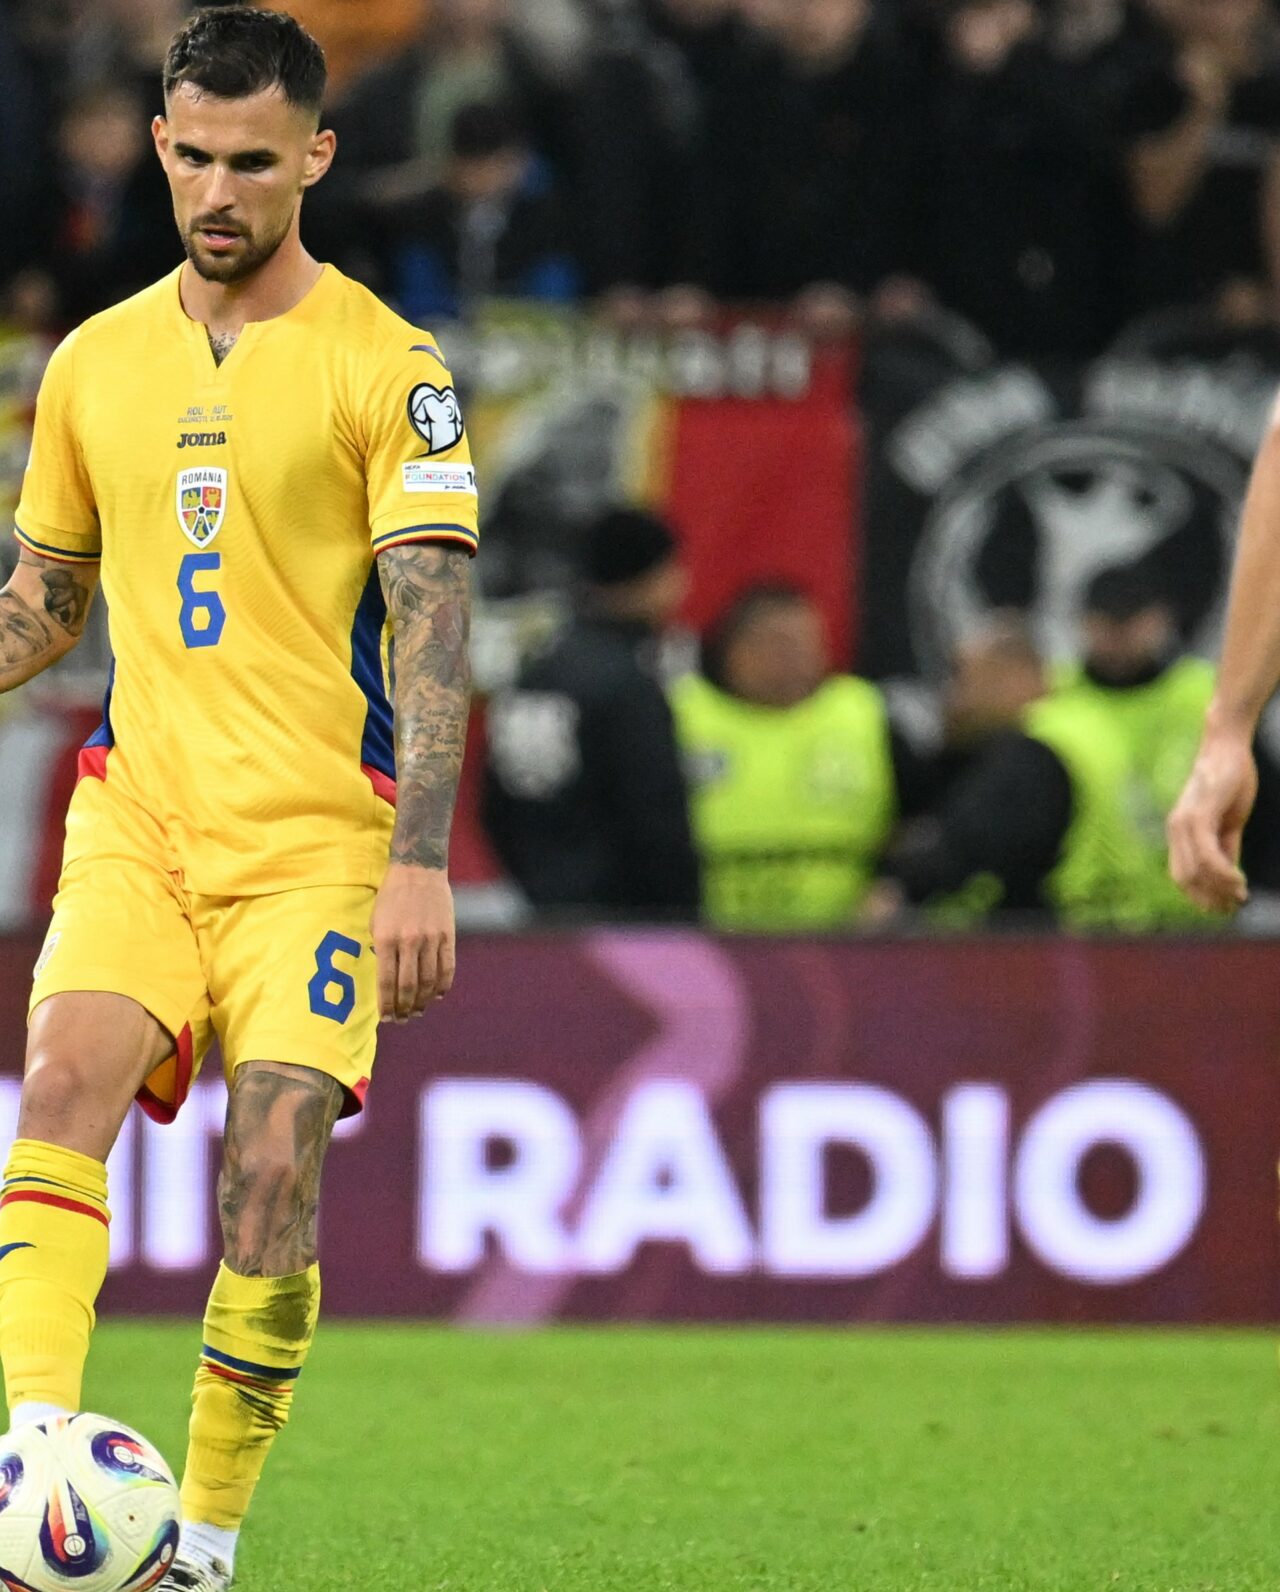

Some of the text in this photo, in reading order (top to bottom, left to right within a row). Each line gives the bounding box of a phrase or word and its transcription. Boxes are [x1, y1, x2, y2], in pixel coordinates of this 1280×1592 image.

[404, 473, 466, 481] FOUNDATION
[177, 552, 226, 649] 6
[308, 929, 362, 1025] 6
[417, 1075, 1205, 1286] RADIO
